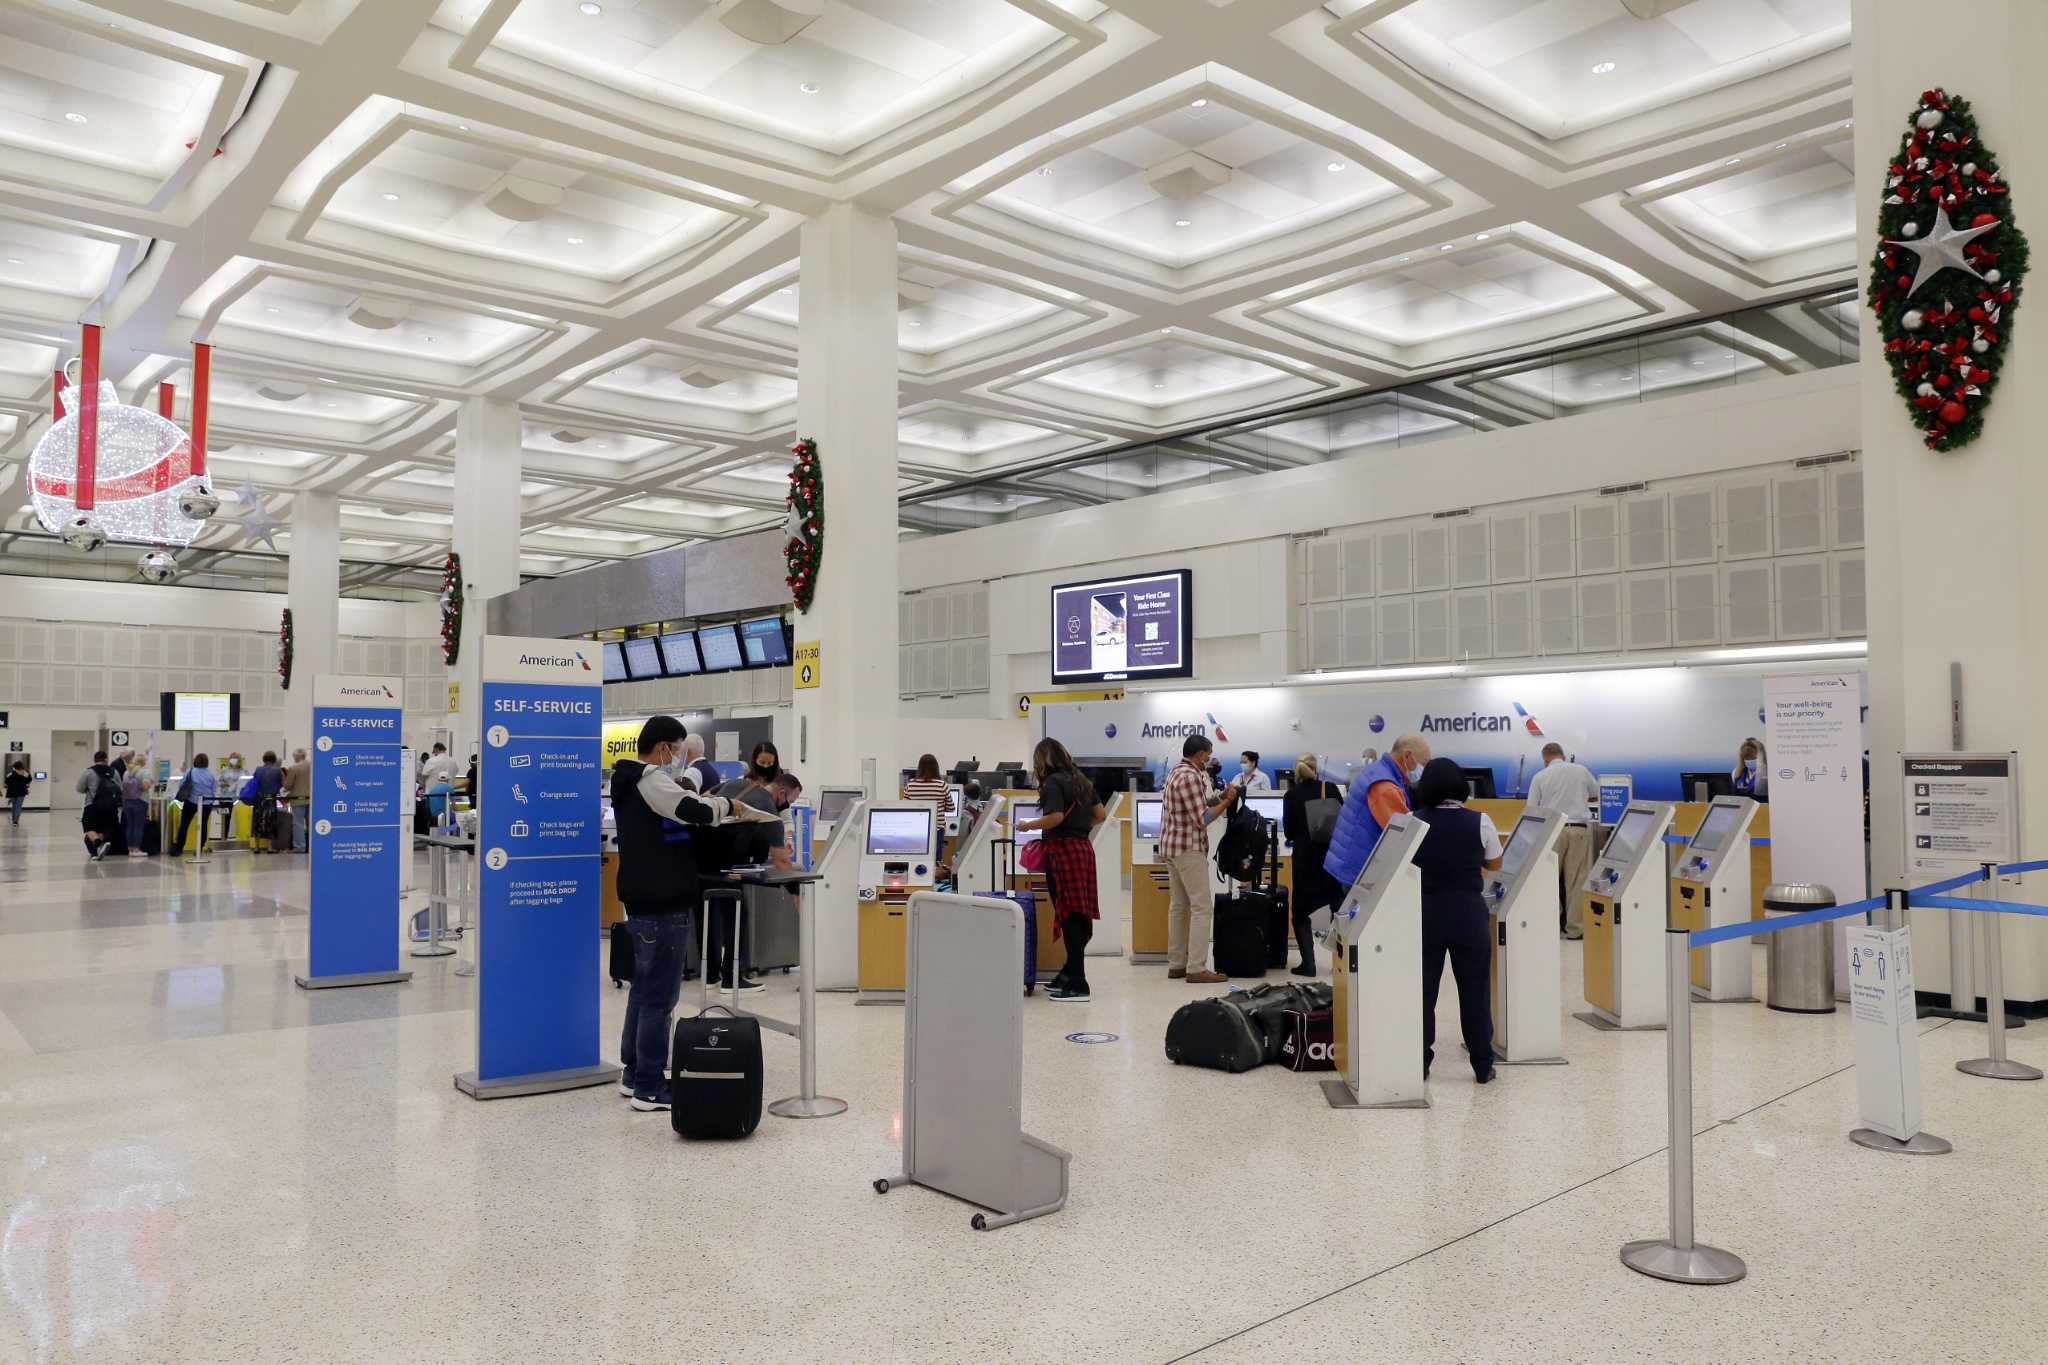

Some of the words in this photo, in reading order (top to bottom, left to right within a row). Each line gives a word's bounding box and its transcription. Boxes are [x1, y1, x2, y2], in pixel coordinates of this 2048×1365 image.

[795, 648, 818, 660] A17-30
[520, 654, 574, 667] American
[340, 687, 381, 696] American
[494, 699, 592, 714] SELF-SERVICE
[1793, 700, 1833, 709] well-being
[1797, 710, 1825, 719] priority
[321, 718, 394, 728] SELF-SERVICE
[1420, 712, 1512, 733] American
[1142, 721, 1206, 738] American
[607, 737, 636, 756] spirit
[493, 856, 500, 867] 2
[558, 887, 577, 895] DROP
